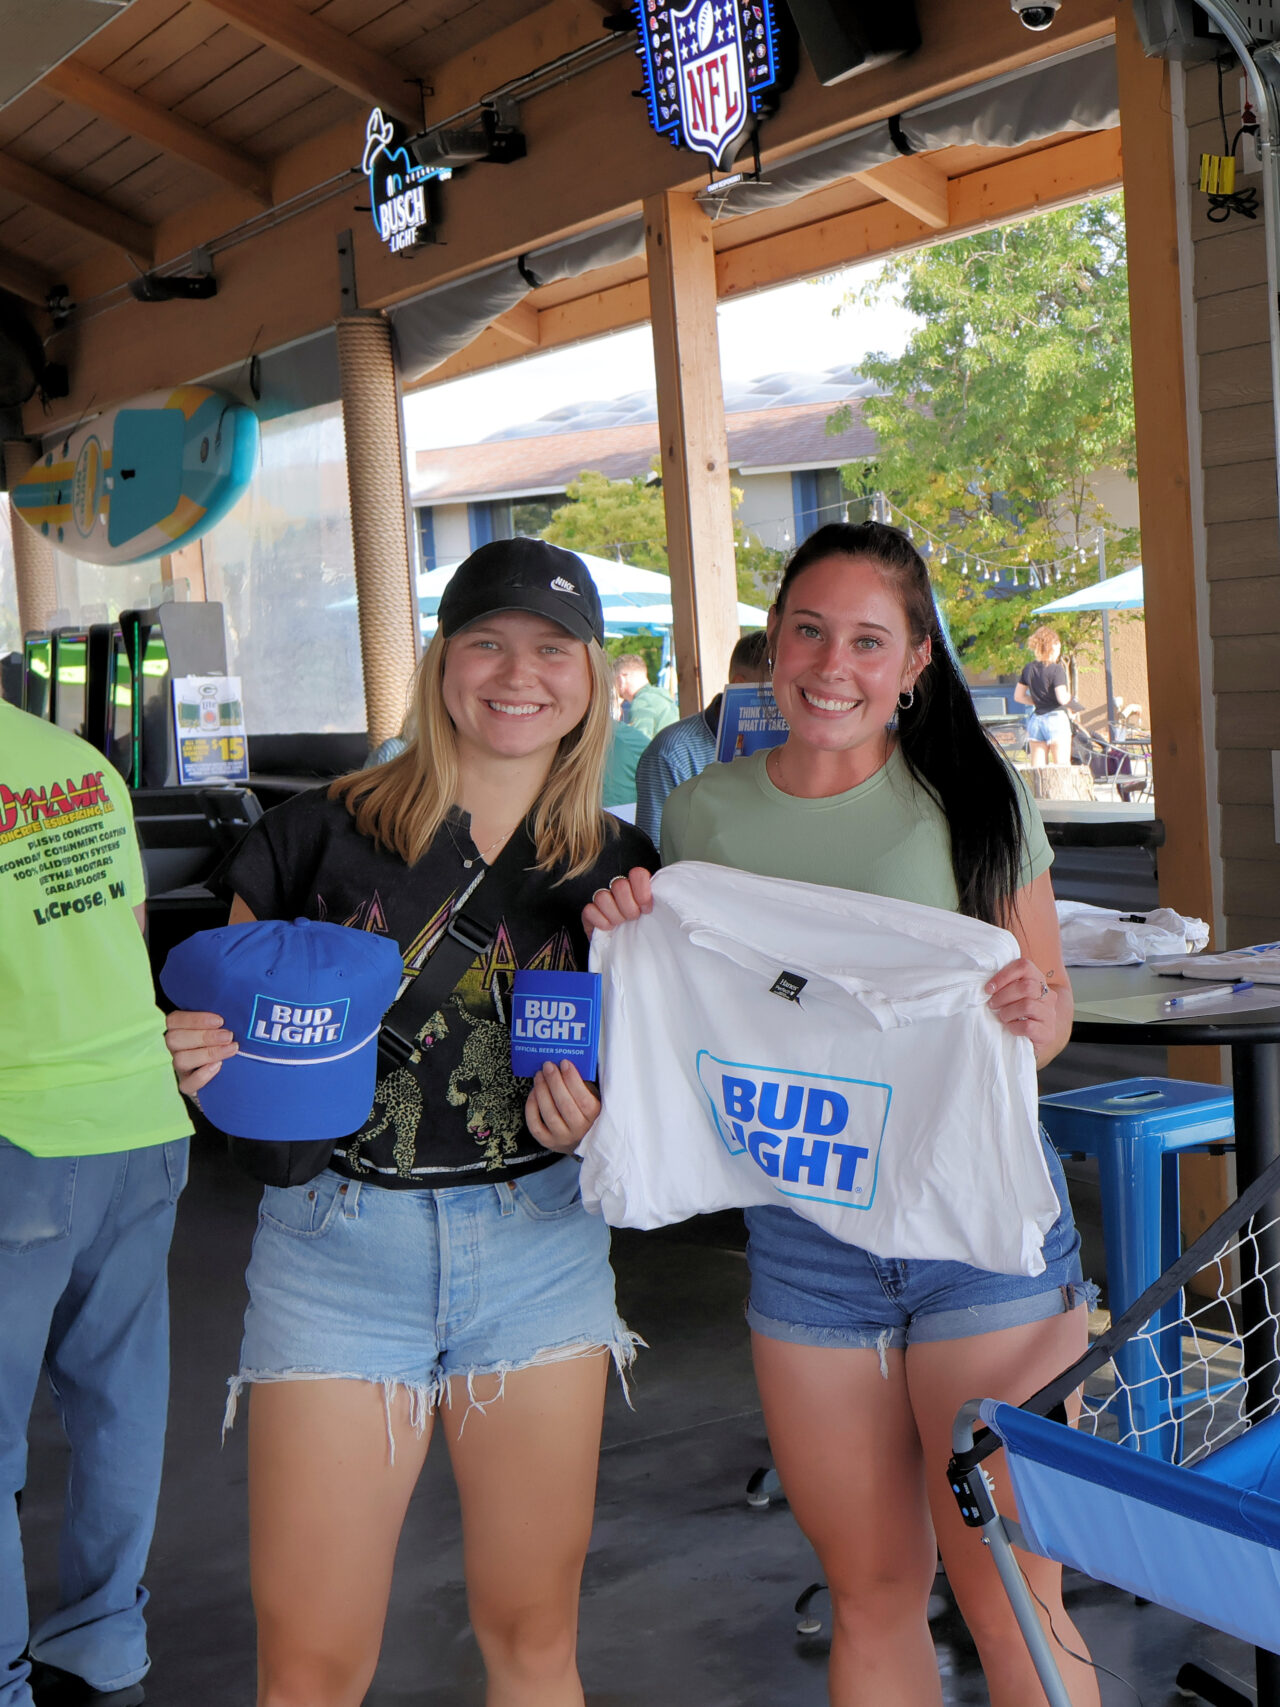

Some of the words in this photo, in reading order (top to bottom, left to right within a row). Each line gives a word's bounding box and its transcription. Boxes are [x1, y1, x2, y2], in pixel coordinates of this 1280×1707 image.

[687, 53, 739, 136] NFL
[378, 185, 427, 242] BUSCH
[390, 227, 417, 253] LIGHT
[555, 576, 575, 591] NIKE
[739, 706, 760, 719] THINK
[738, 719, 759, 732] WHAT
[759, 719, 767, 731] IT
[211, 737, 245, 761] $15
[270, 1004, 333, 1027] BUD
[524, 999, 577, 1021] BUD
[254, 1019, 341, 1045] LIGHT
[515, 1018, 586, 1041] LIGHT
[514, 1045, 538, 1053] OFFICIAL
[538, 1046, 554, 1054] BEER
[554, 1047, 585, 1055] SPONSOR
[721, 1074, 849, 1137] BUD
[720, 1114, 869, 1192] IGHT
